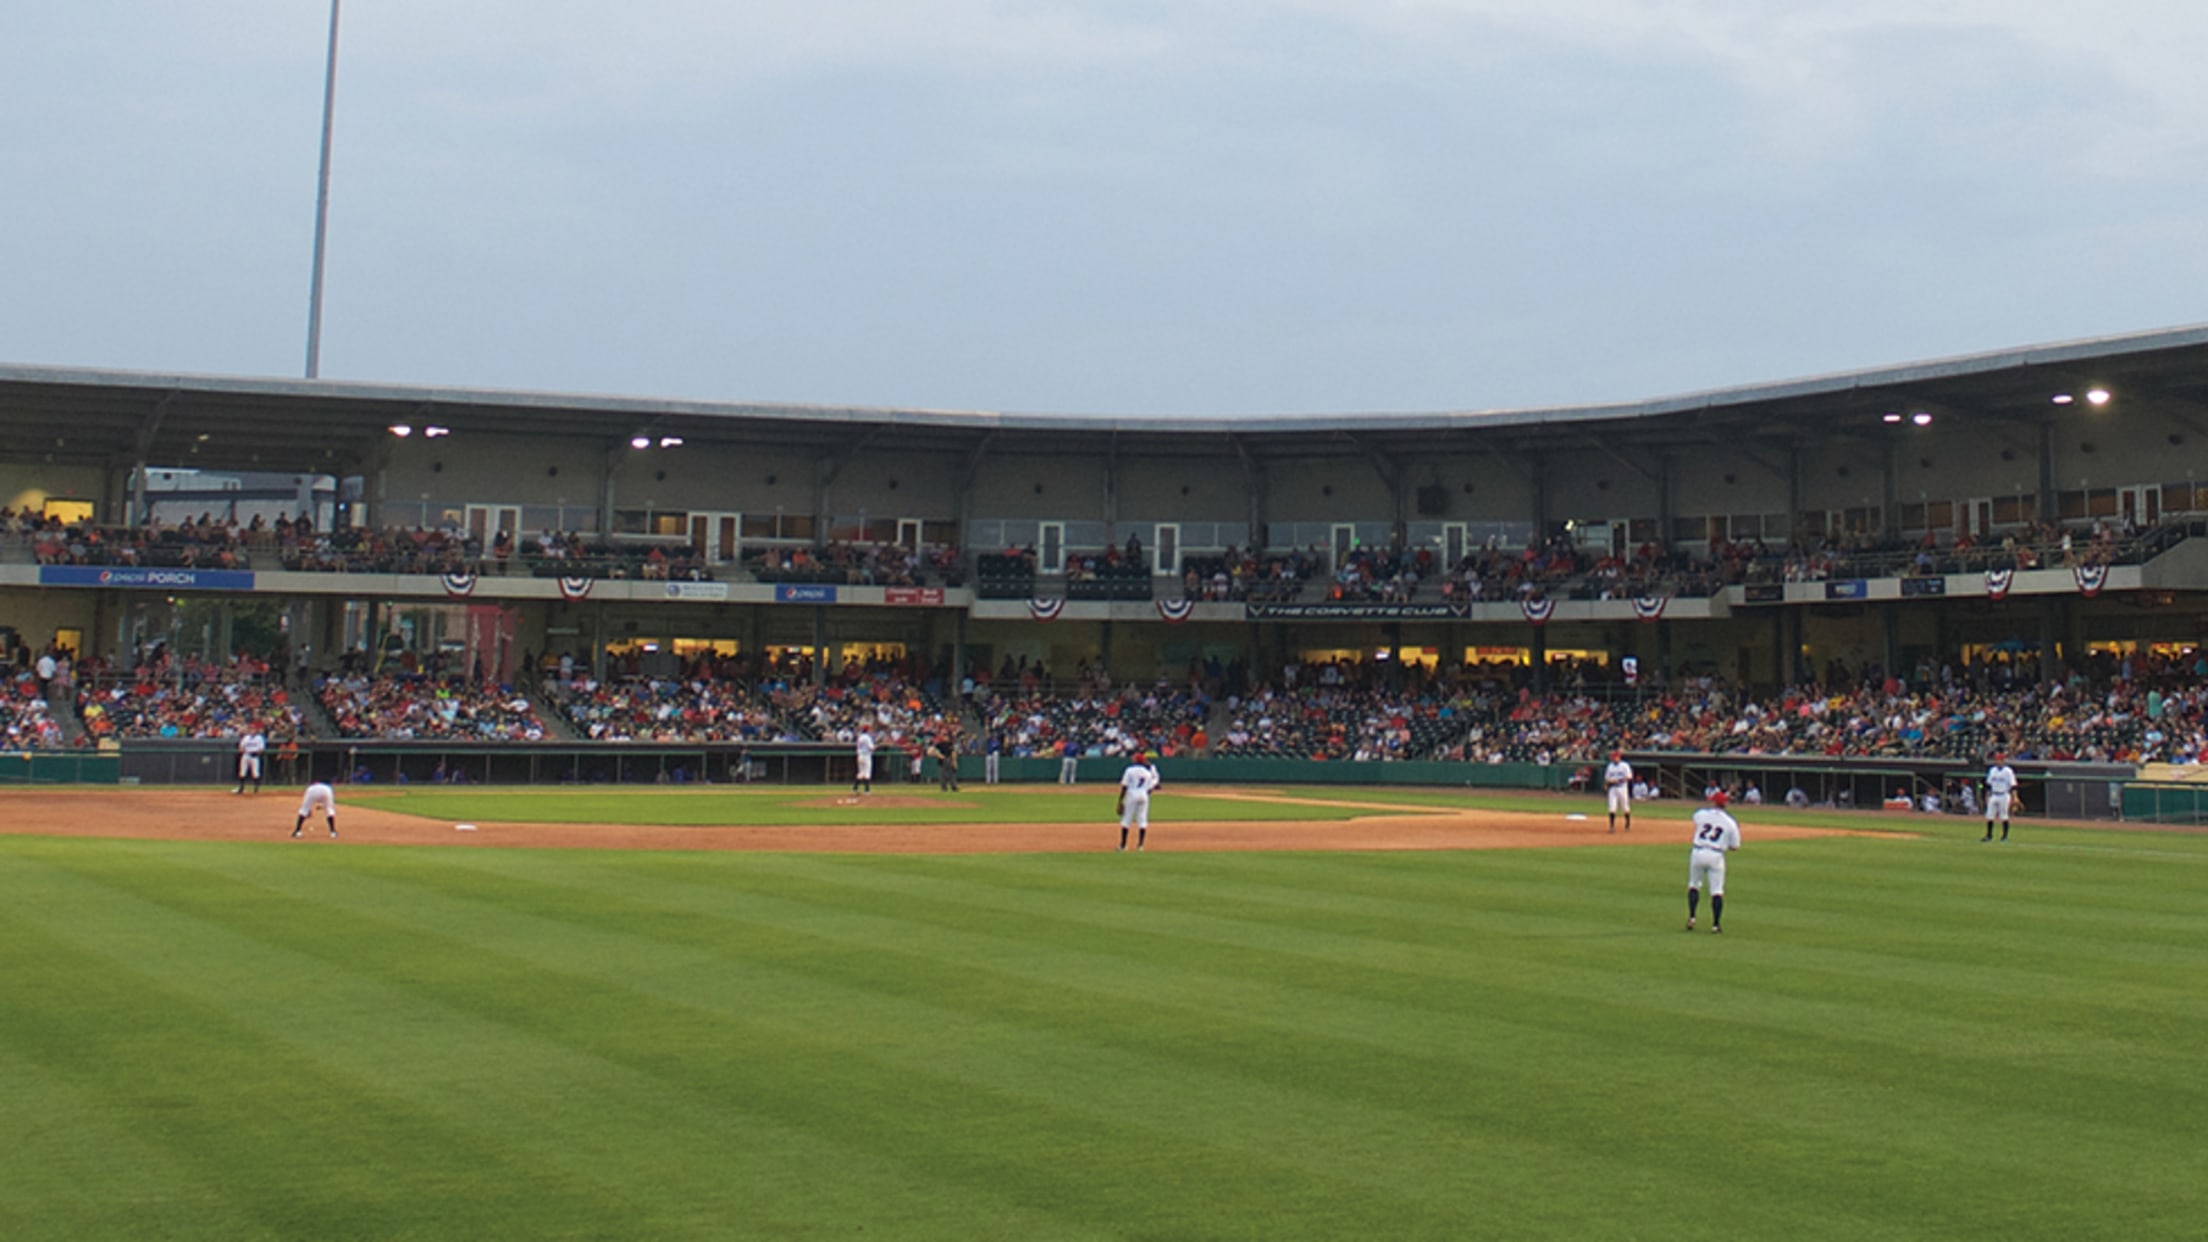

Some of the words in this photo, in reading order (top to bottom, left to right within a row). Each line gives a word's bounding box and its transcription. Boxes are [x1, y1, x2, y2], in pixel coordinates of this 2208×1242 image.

[147, 572, 195, 584] PORCH
[1266, 607, 1301, 616] THE
[1304, 607, 1399, 616] CORVETTE
[1401, 607, 1448, 616] CLUB
[1699, 823, 1724, 843] 23
